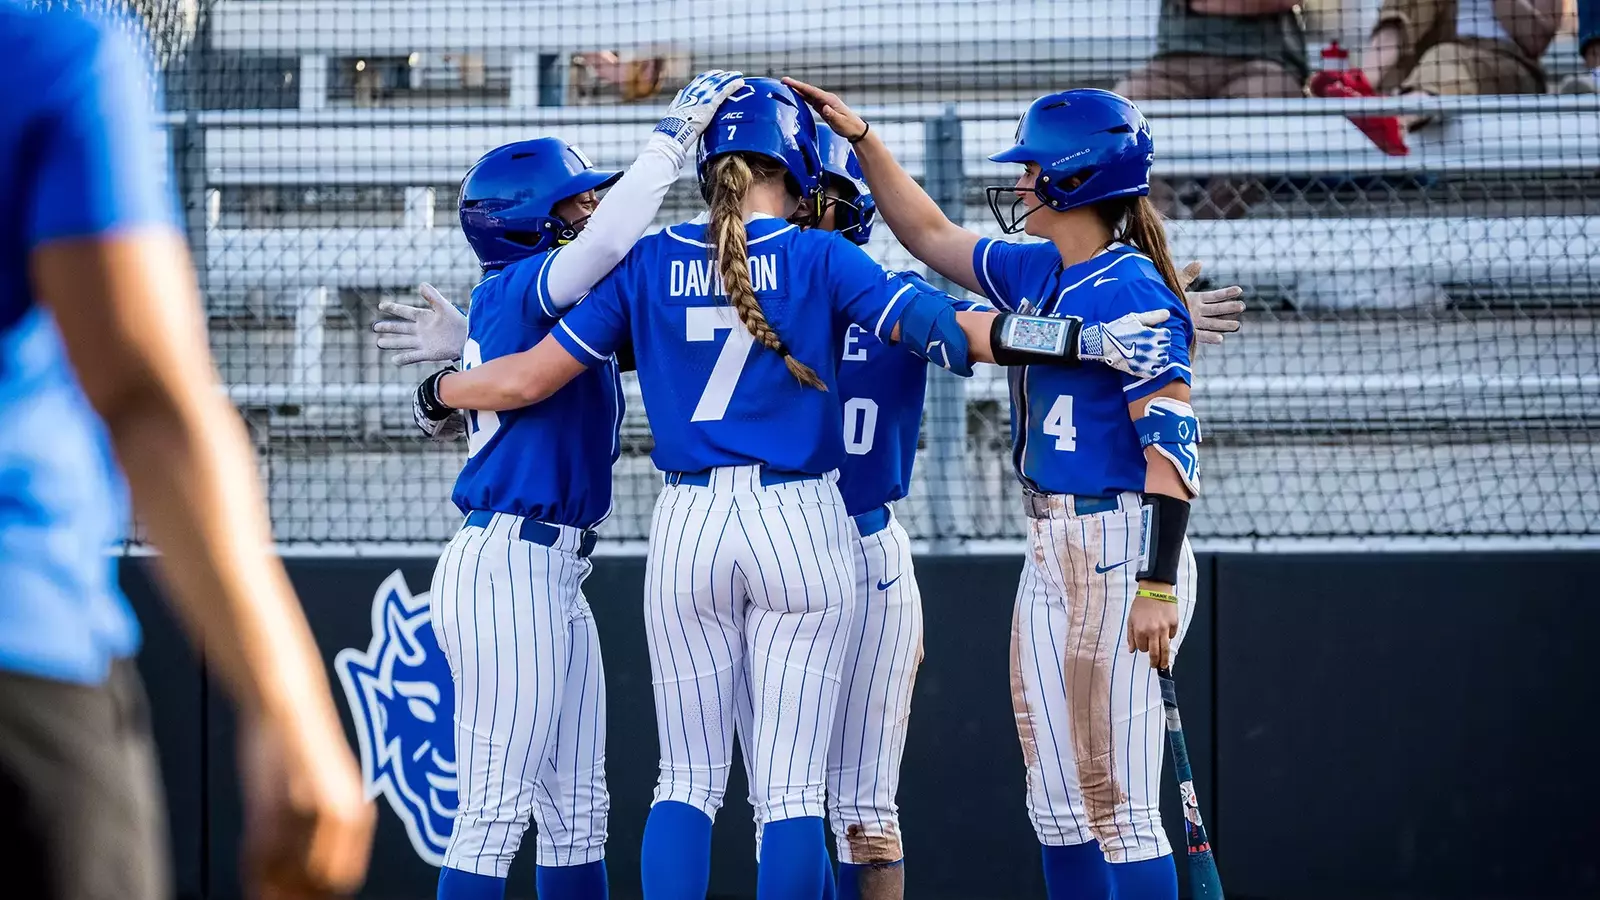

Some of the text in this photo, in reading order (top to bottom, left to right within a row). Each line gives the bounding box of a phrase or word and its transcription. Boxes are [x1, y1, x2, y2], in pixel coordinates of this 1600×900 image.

[721, 111, 744, 120] ACC
[677, 126, 693, 144] DUKE
[727, 125, 737, 141] 7
[1052, 148, 1091, 167] EVOSHIELD
[669, 254, 778, 297] DAVION
[686, 306, 756, 422] 7
[1043, 395, 1077, 452] 4
[1140, 431, 1161, 449] VILS
